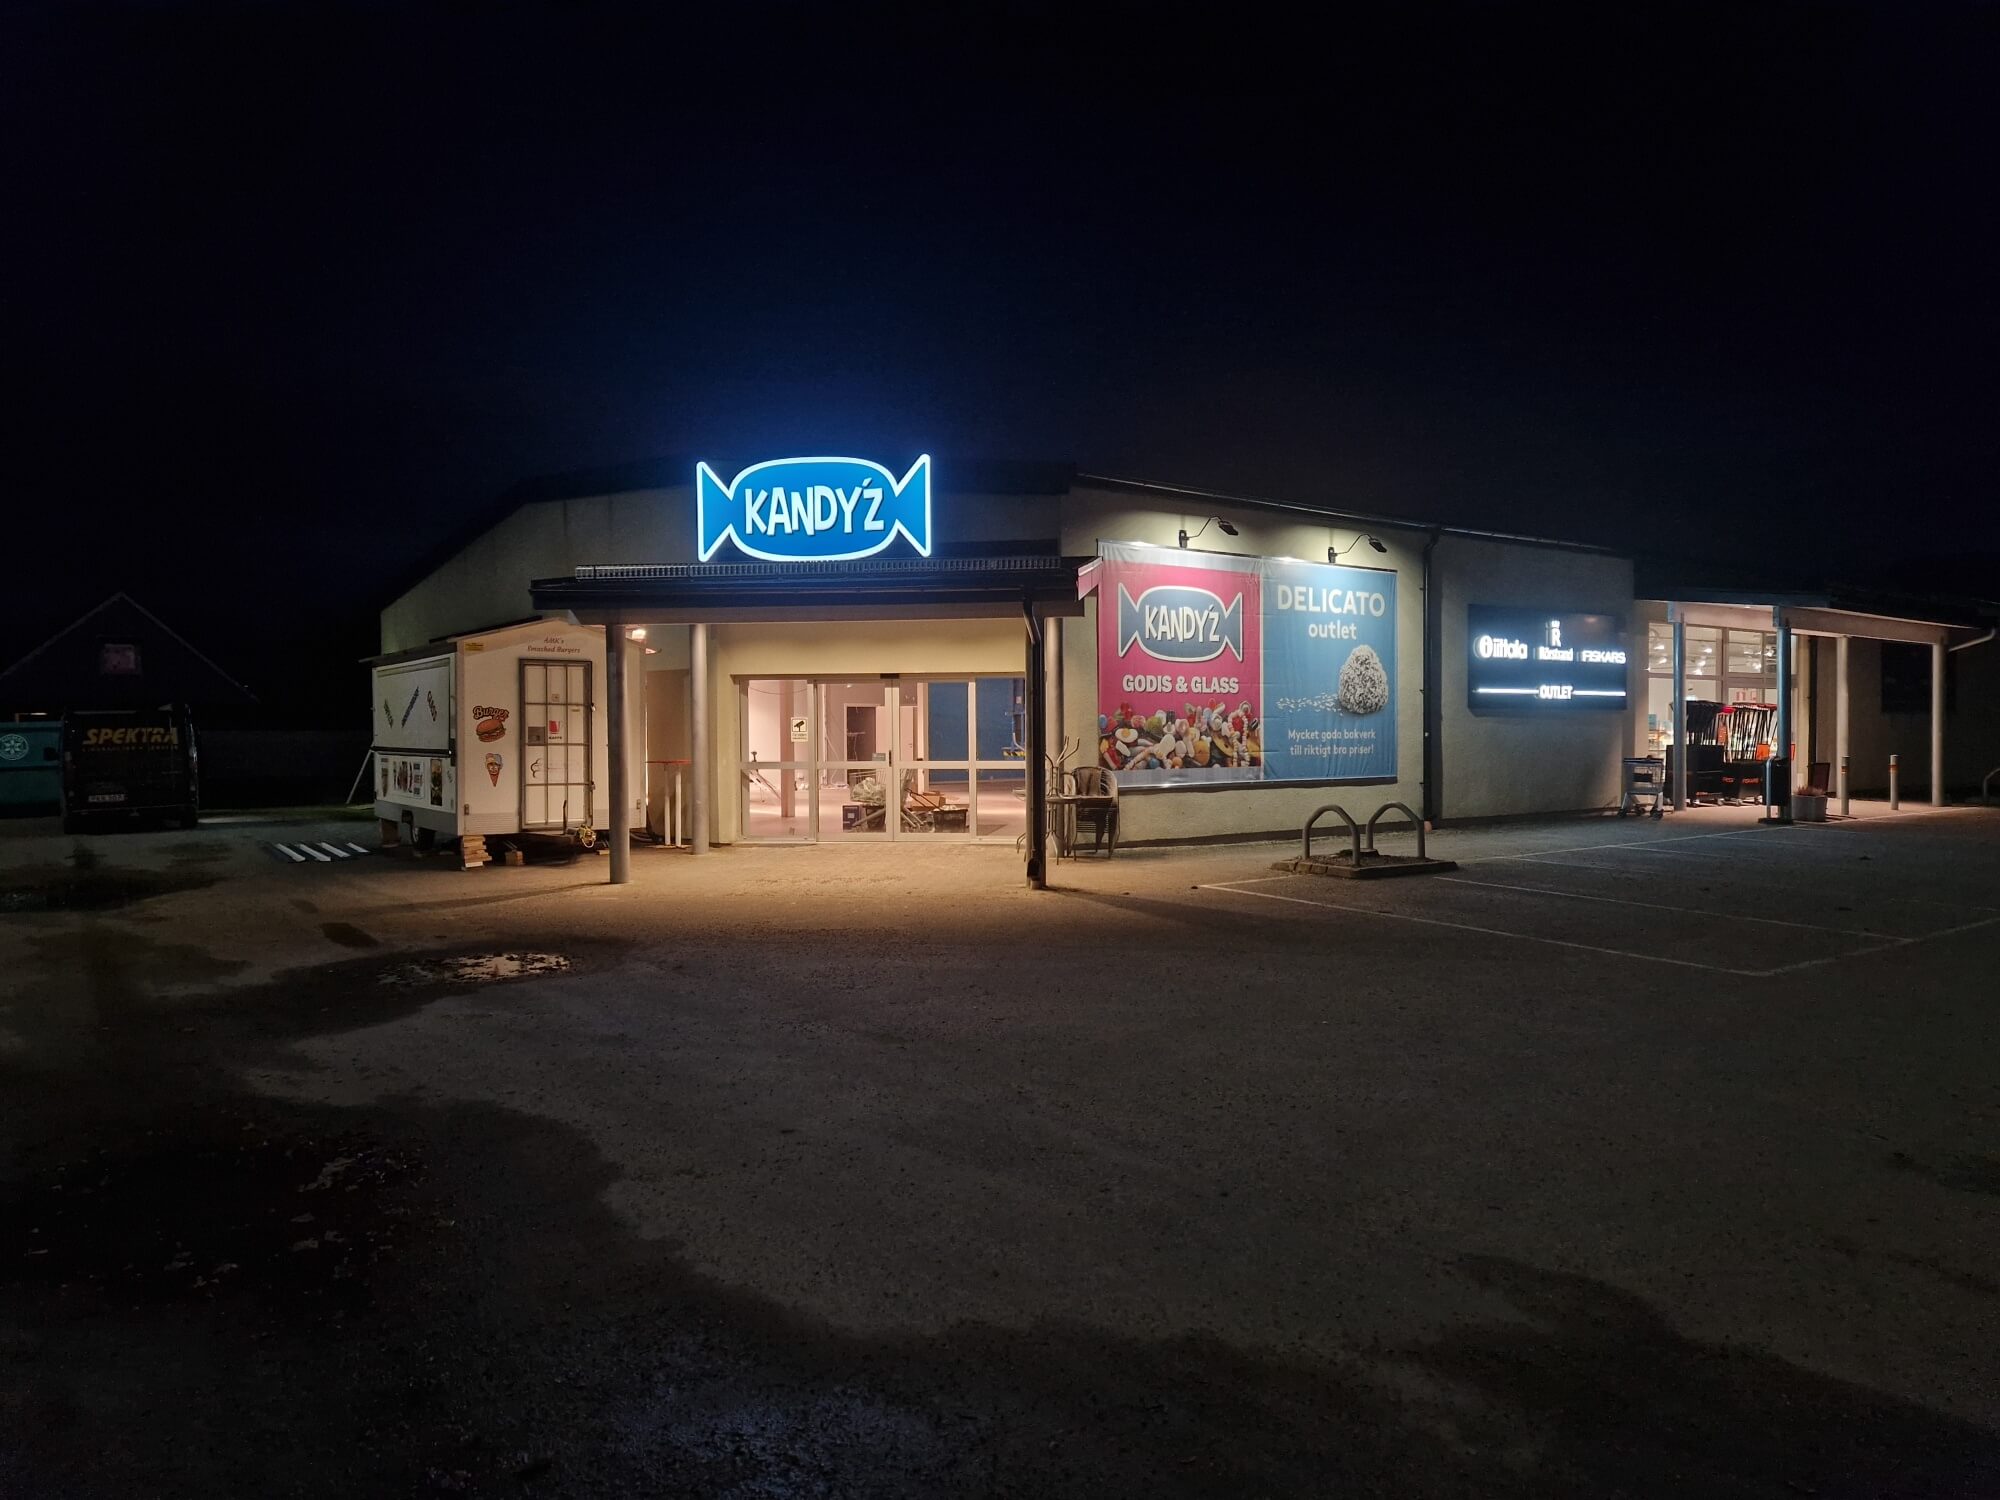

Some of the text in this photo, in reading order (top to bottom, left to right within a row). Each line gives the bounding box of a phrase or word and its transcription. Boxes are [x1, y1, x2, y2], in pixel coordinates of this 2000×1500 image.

[1277, 584, 1386, 617] DELICATO
[1308, 620, 1357, 640] outlet
[1581, 649, 1627, 665] FISKARS
[1122, 674, 1240, 694] GODIS & GLASS
[1539, 684, 1574, 700] OUTLET
[473, 705, 510, 722] Burger
[82, 727, 179, 745] SPEKTRA
[1287, 729, 1376, 742] Mycket goda bakverk
[1290, 744, 1374, 758] till riktigt bra priser!
